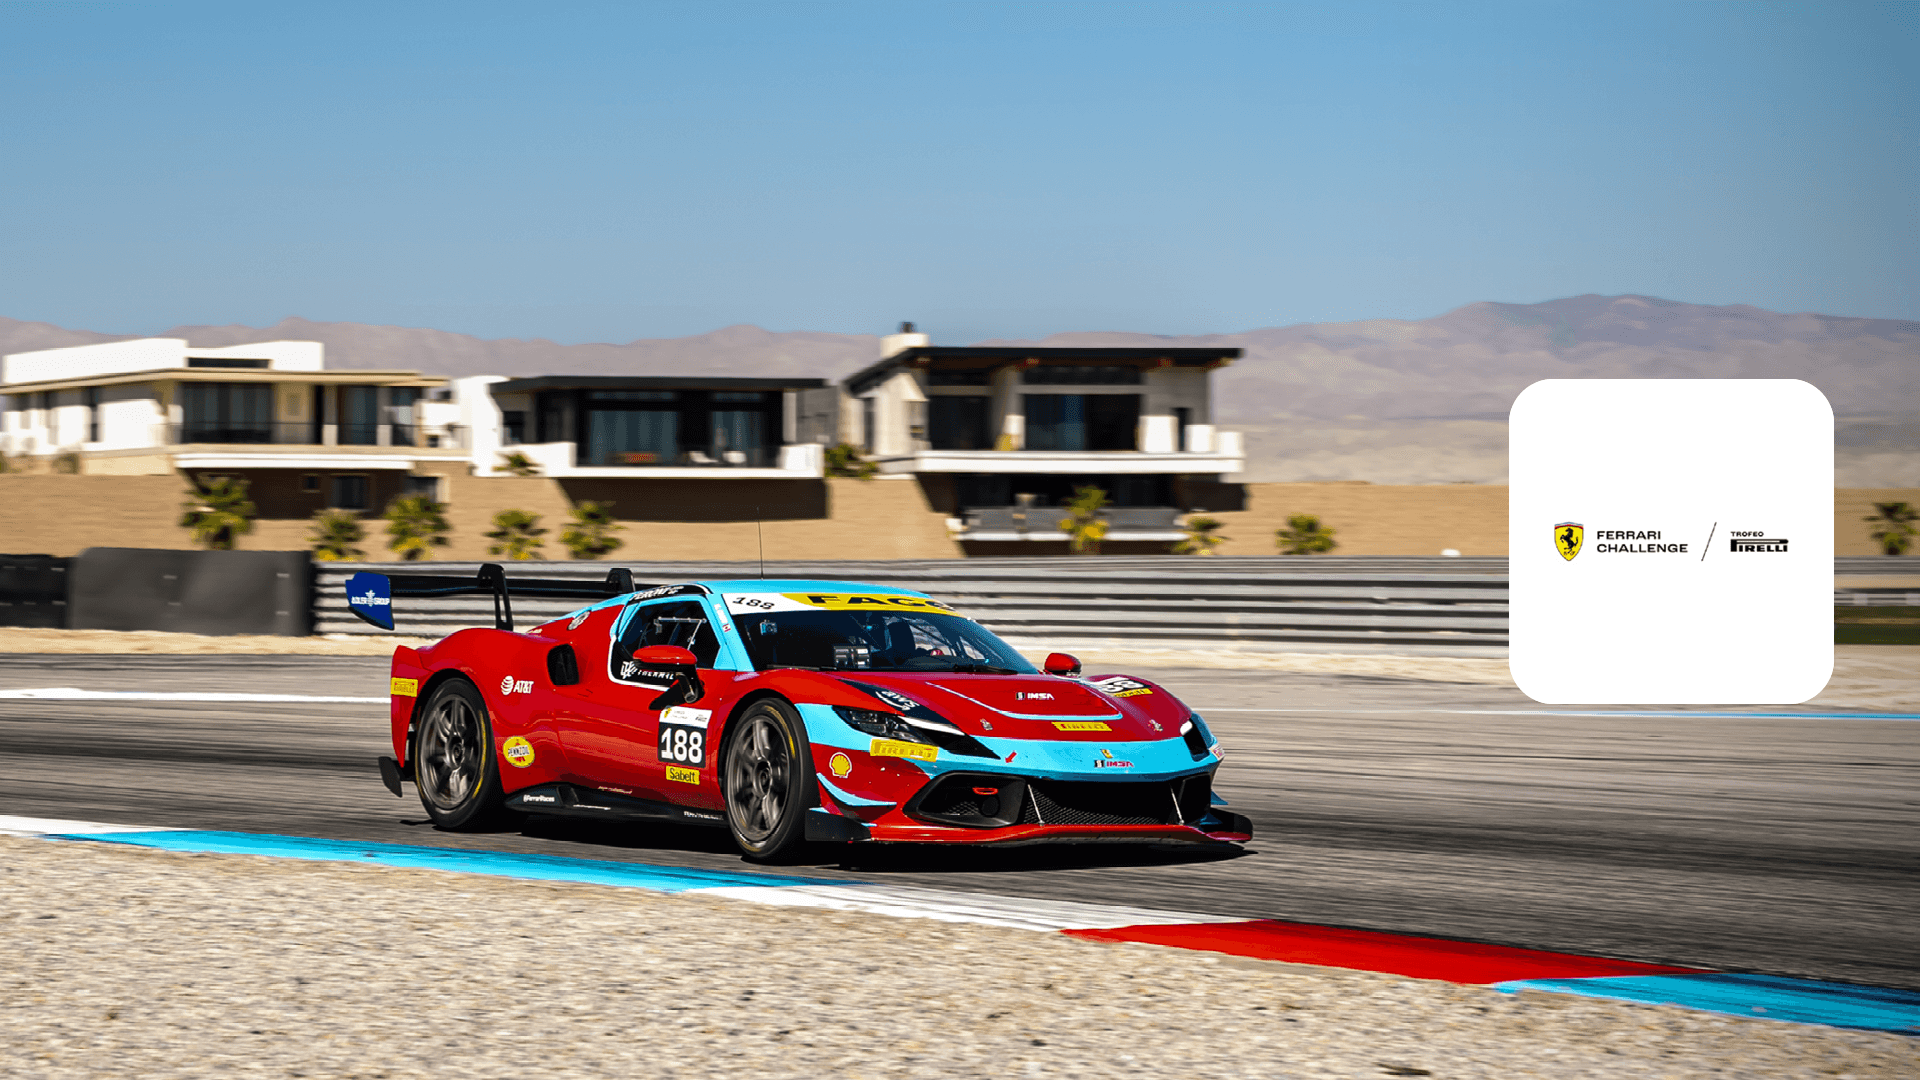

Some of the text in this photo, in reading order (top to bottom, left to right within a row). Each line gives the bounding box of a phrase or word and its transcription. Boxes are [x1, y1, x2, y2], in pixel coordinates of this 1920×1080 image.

[732, 597, 775, 611] 188
[512, 679, 535, 694] AT&T
[1027, 692, 1055, 701] IMSA
[661, 727, 703, 764] 188
[669, 767, 696, 782] Sabelt
